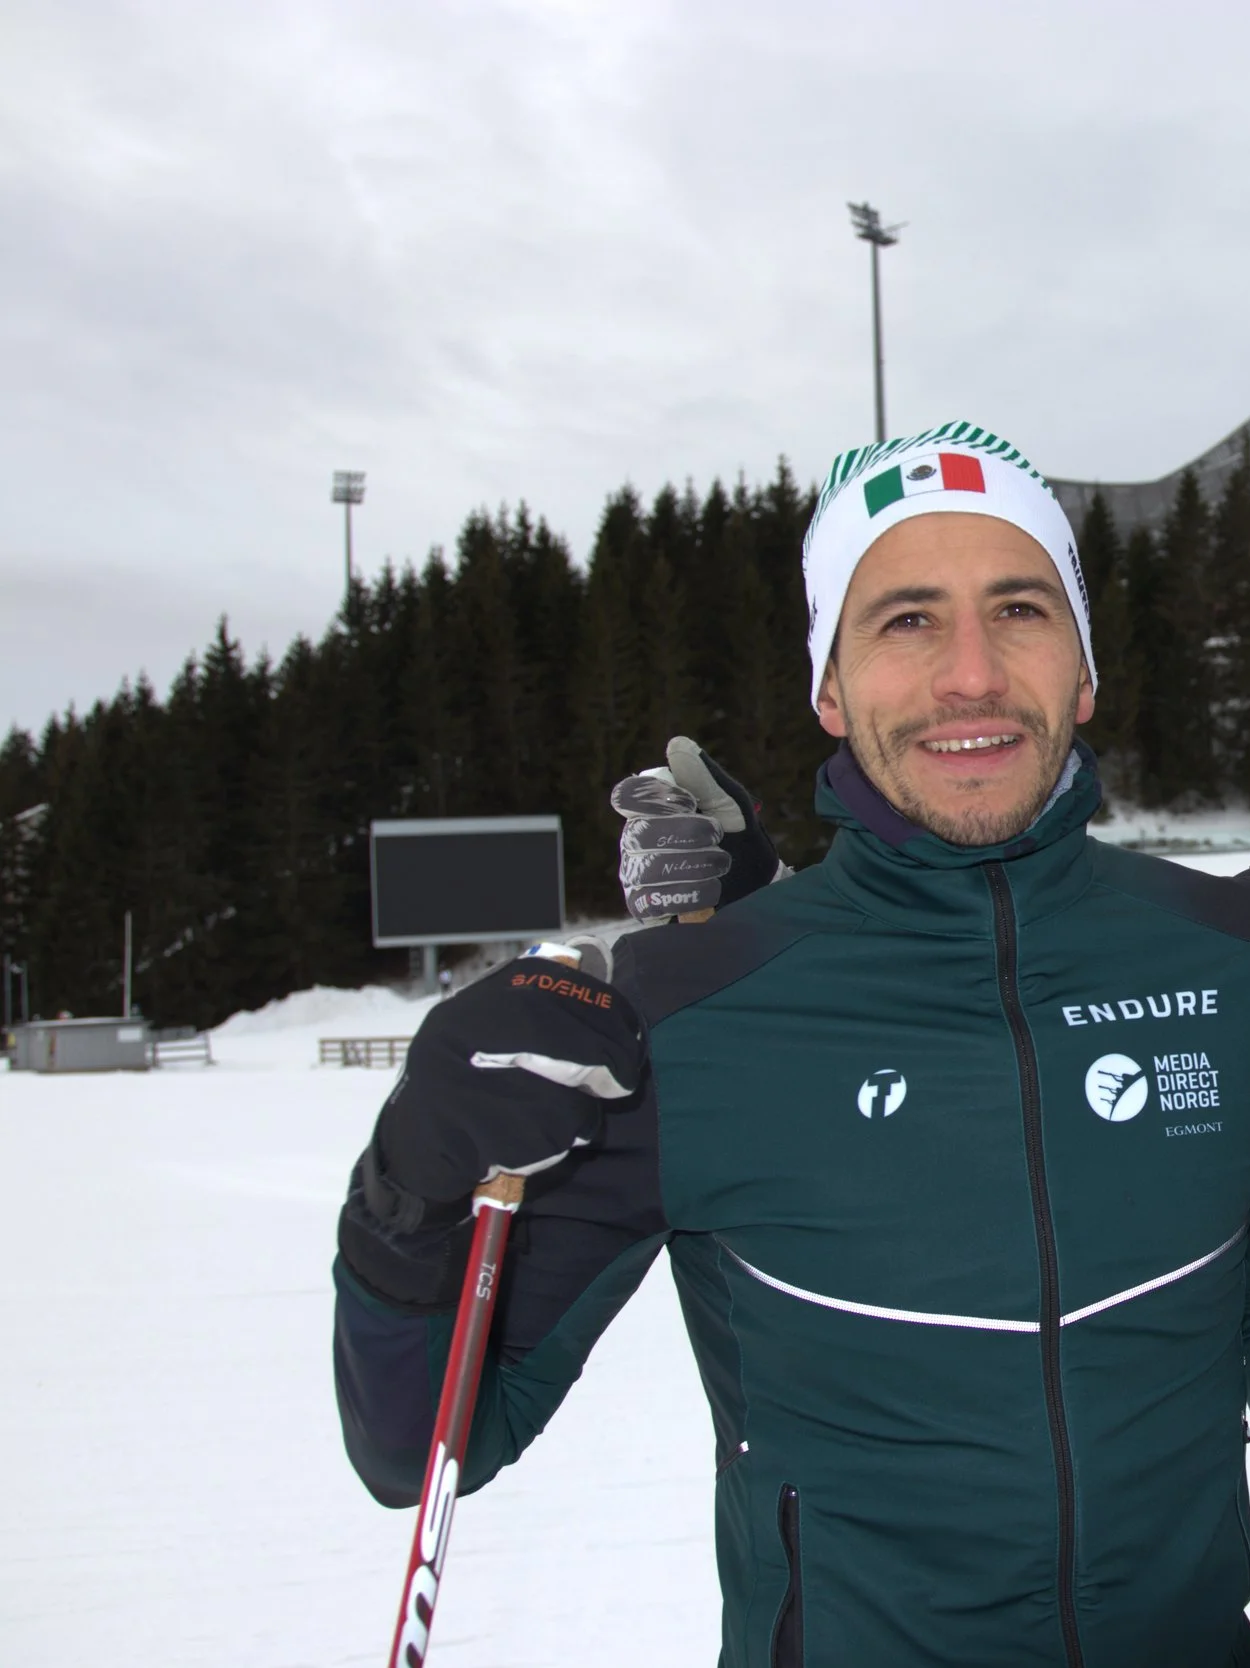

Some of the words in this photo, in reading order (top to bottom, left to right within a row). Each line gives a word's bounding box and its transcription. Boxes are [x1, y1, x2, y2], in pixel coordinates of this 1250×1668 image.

[1061, 989, 1219, 1027] ENDURE
[1153, 1052, 1211, 1073] MEDIA
[1156, 1070, 1219, 1092] DIRECT
[1159, 1089, 1221, 1112] NORGE
[1165, 1121, 1223, 1137] EGMONT
[476, 1262, 497, 1301] TCS
